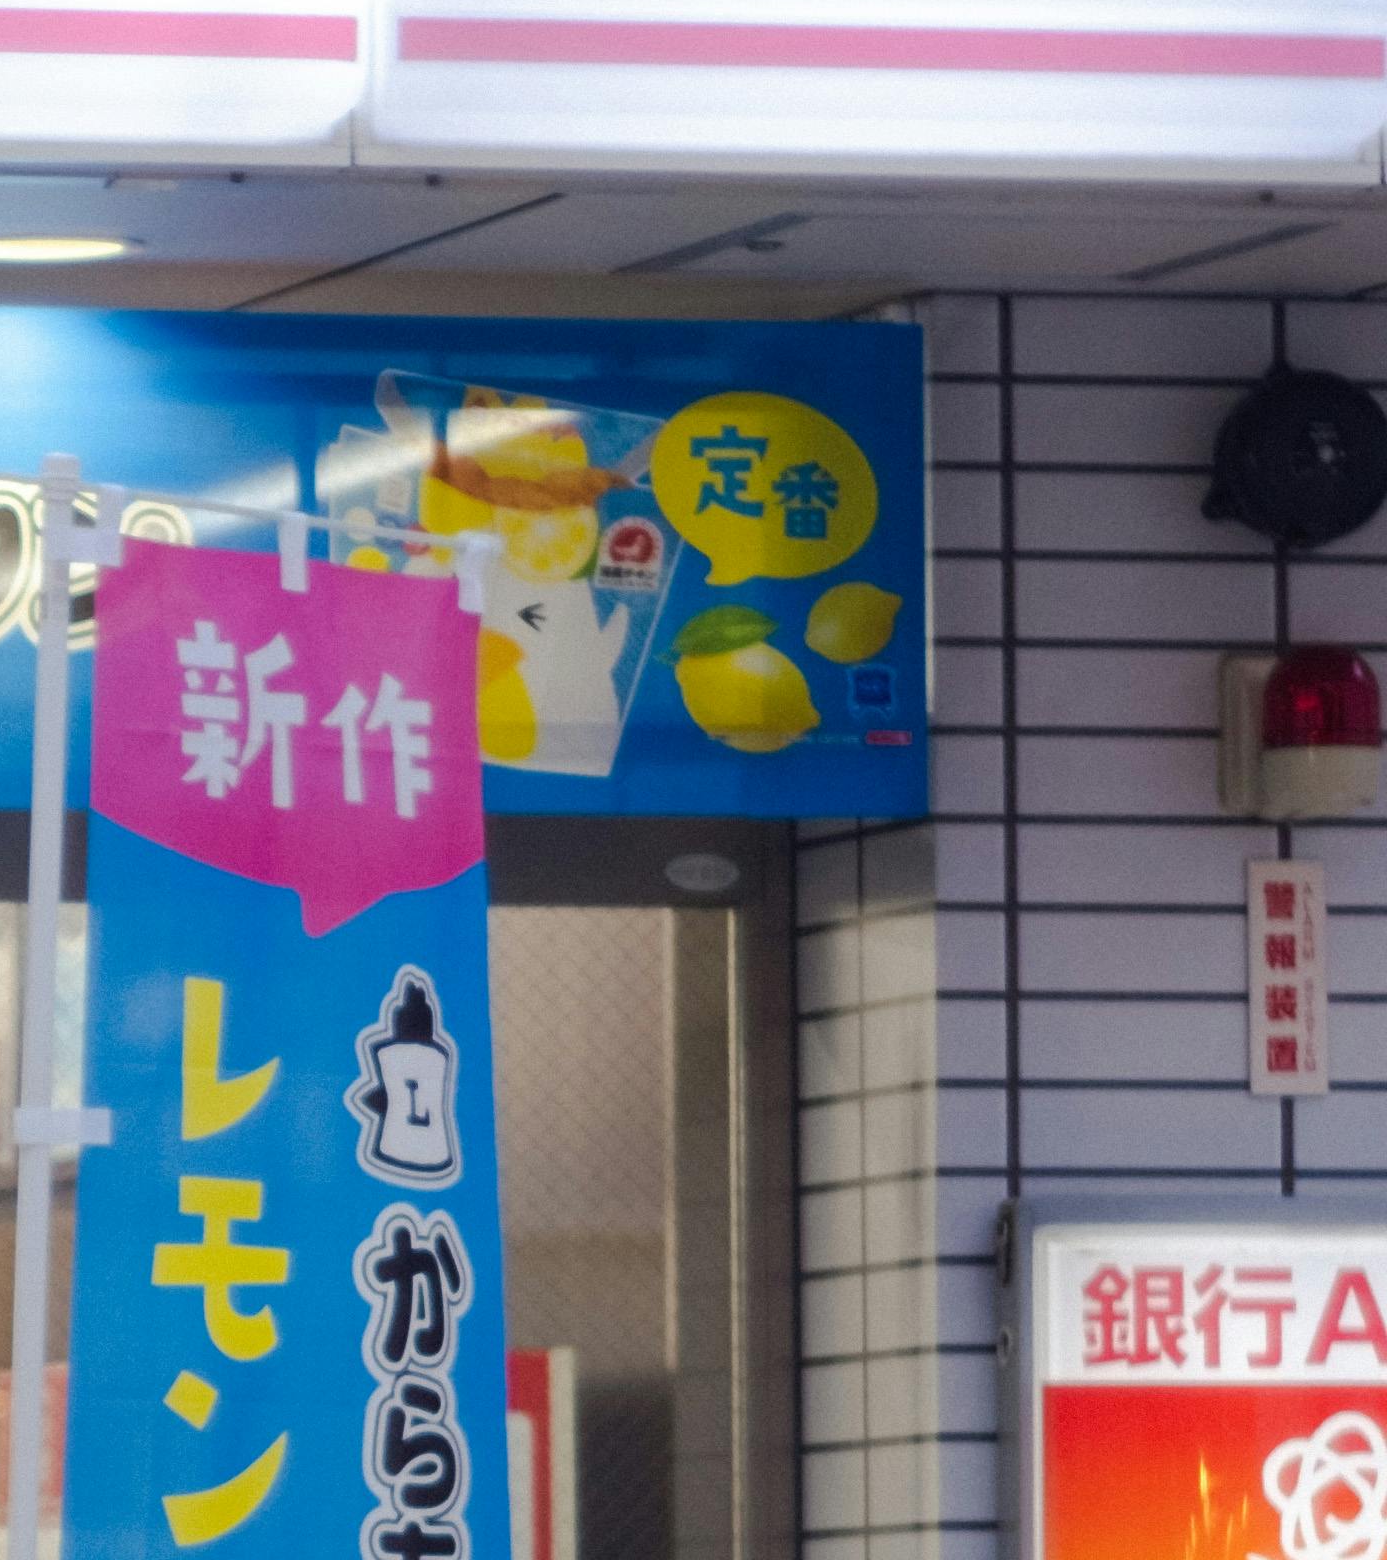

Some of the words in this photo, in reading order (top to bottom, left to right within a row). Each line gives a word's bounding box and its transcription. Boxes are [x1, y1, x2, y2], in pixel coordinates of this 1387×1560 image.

[689, 425, 840, 540] 定番
[174, 620, 434, 819] 新作
[1081, 1263, 1387, 1369] 銀行A
